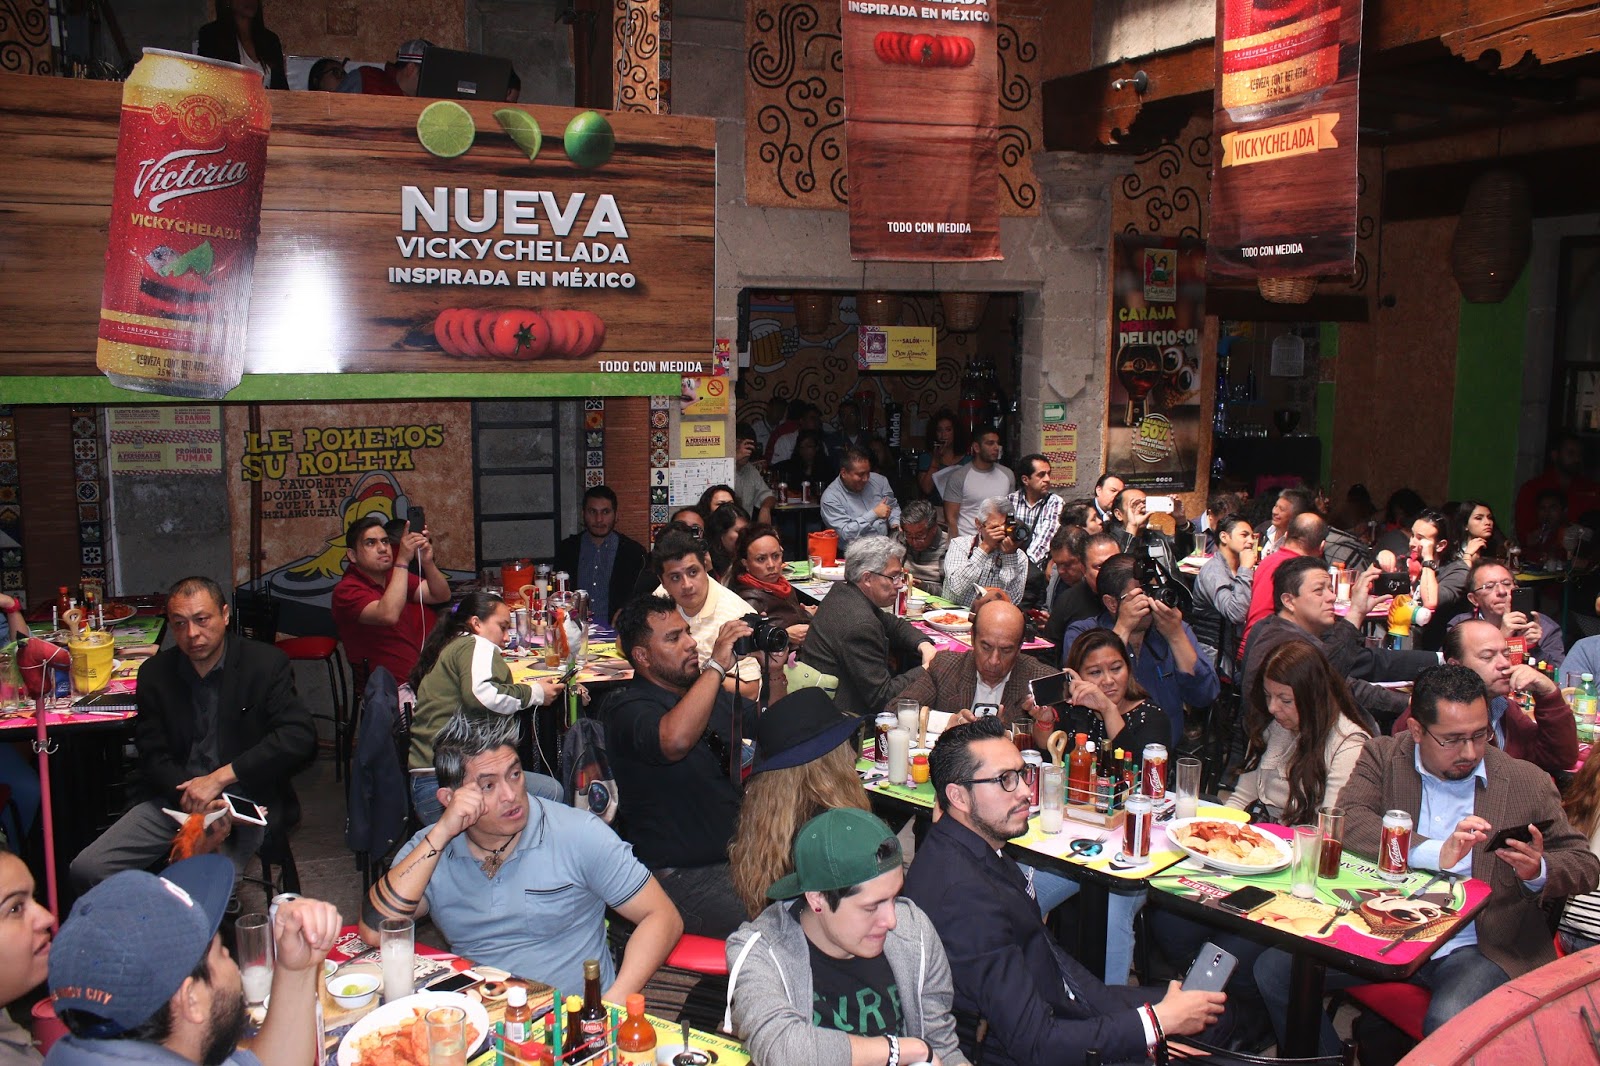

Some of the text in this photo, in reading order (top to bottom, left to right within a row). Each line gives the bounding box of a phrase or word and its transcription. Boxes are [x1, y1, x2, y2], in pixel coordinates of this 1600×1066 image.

[848, 2, 918, 18] INSPIRADA
[921, 7, 939, 20] EN
[941, 7, 990, 23] MÉXICO
[1234, 126, 1315, 160] VICKYCHELADA
[133, 143, 249, 213] Victoria
[401, 185, 629, 239] NUEVA
[131, 212, 243, 241] VICKYCHELADA
[887, 221, 972, 234] TODO CON MEDIDA
[395, 235, 630, 264] VICKYCHELADA
[1241, 243, 1304, 258] TODO CON MEDIDA
[388, 267, 637, 289] INSPIRADA EN MÉXICO
[1119, 305, 1177, 322] CARAJA
[1119, 328, 1199, 347] DELICIOSO!
[598, 360, 703, 373] TODO CON MEDIDA
[244, 424, 445, 454] LE PONEMOS
[889, 413, 901, 447] Modelo
[1140, 422, 1168, 441] 50%
[175, 447, 213, 455] PROHIBIDO
[175, 454, 213, 462] FUMAR
[241, 448, 416, 482] SU ROLITA
[278, 477, 353, 490] FAVORITA
[263, 488, 347, 503] DONDE MAS
[320, 498, 338, 509] LA
[1148, 766, 1164, 793] Victoria
[1387, 837, 1405, 868] Victoria
[1182, 880, 1229, 897] MIRNOFF
[85, 987, 113, 1005] CITY
